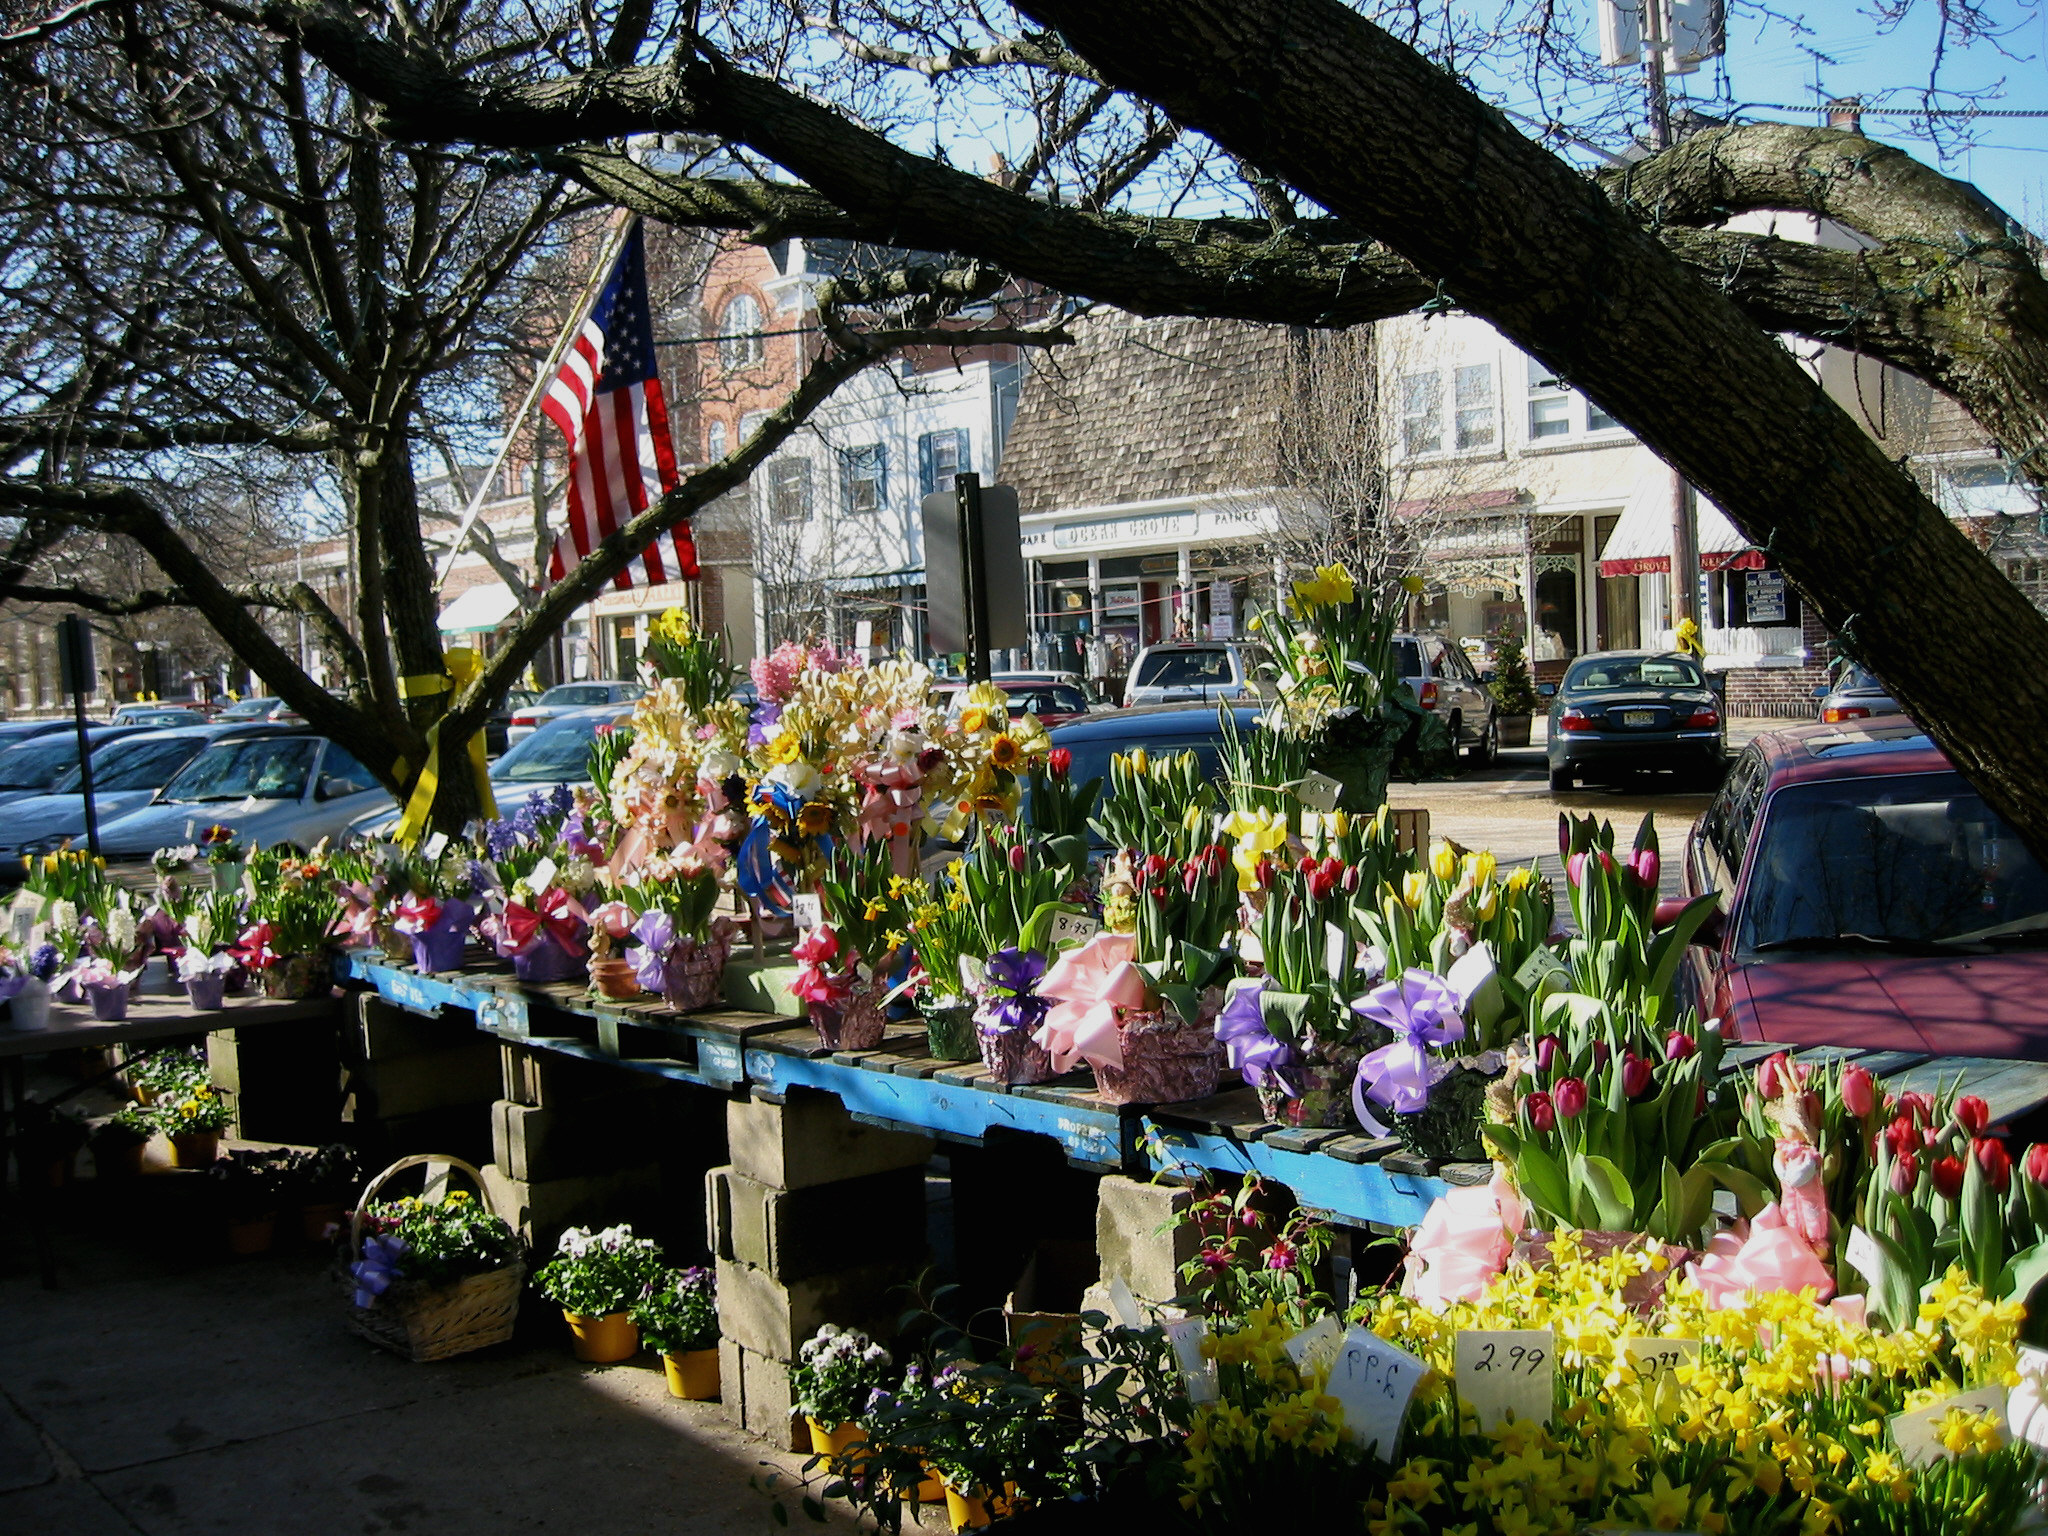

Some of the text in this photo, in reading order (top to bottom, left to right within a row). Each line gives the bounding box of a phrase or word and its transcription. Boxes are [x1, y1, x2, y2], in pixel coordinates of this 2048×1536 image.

[1214, 510, 1258, 525] PAINTS
[1069, 516, 1181, 543] OCEAN GROVE
[1634, 561, 1669, 571] GROVE
[1059, 917, 1094, 935] 8.95
[1474, 1342, 1545, 1375] 2.99
